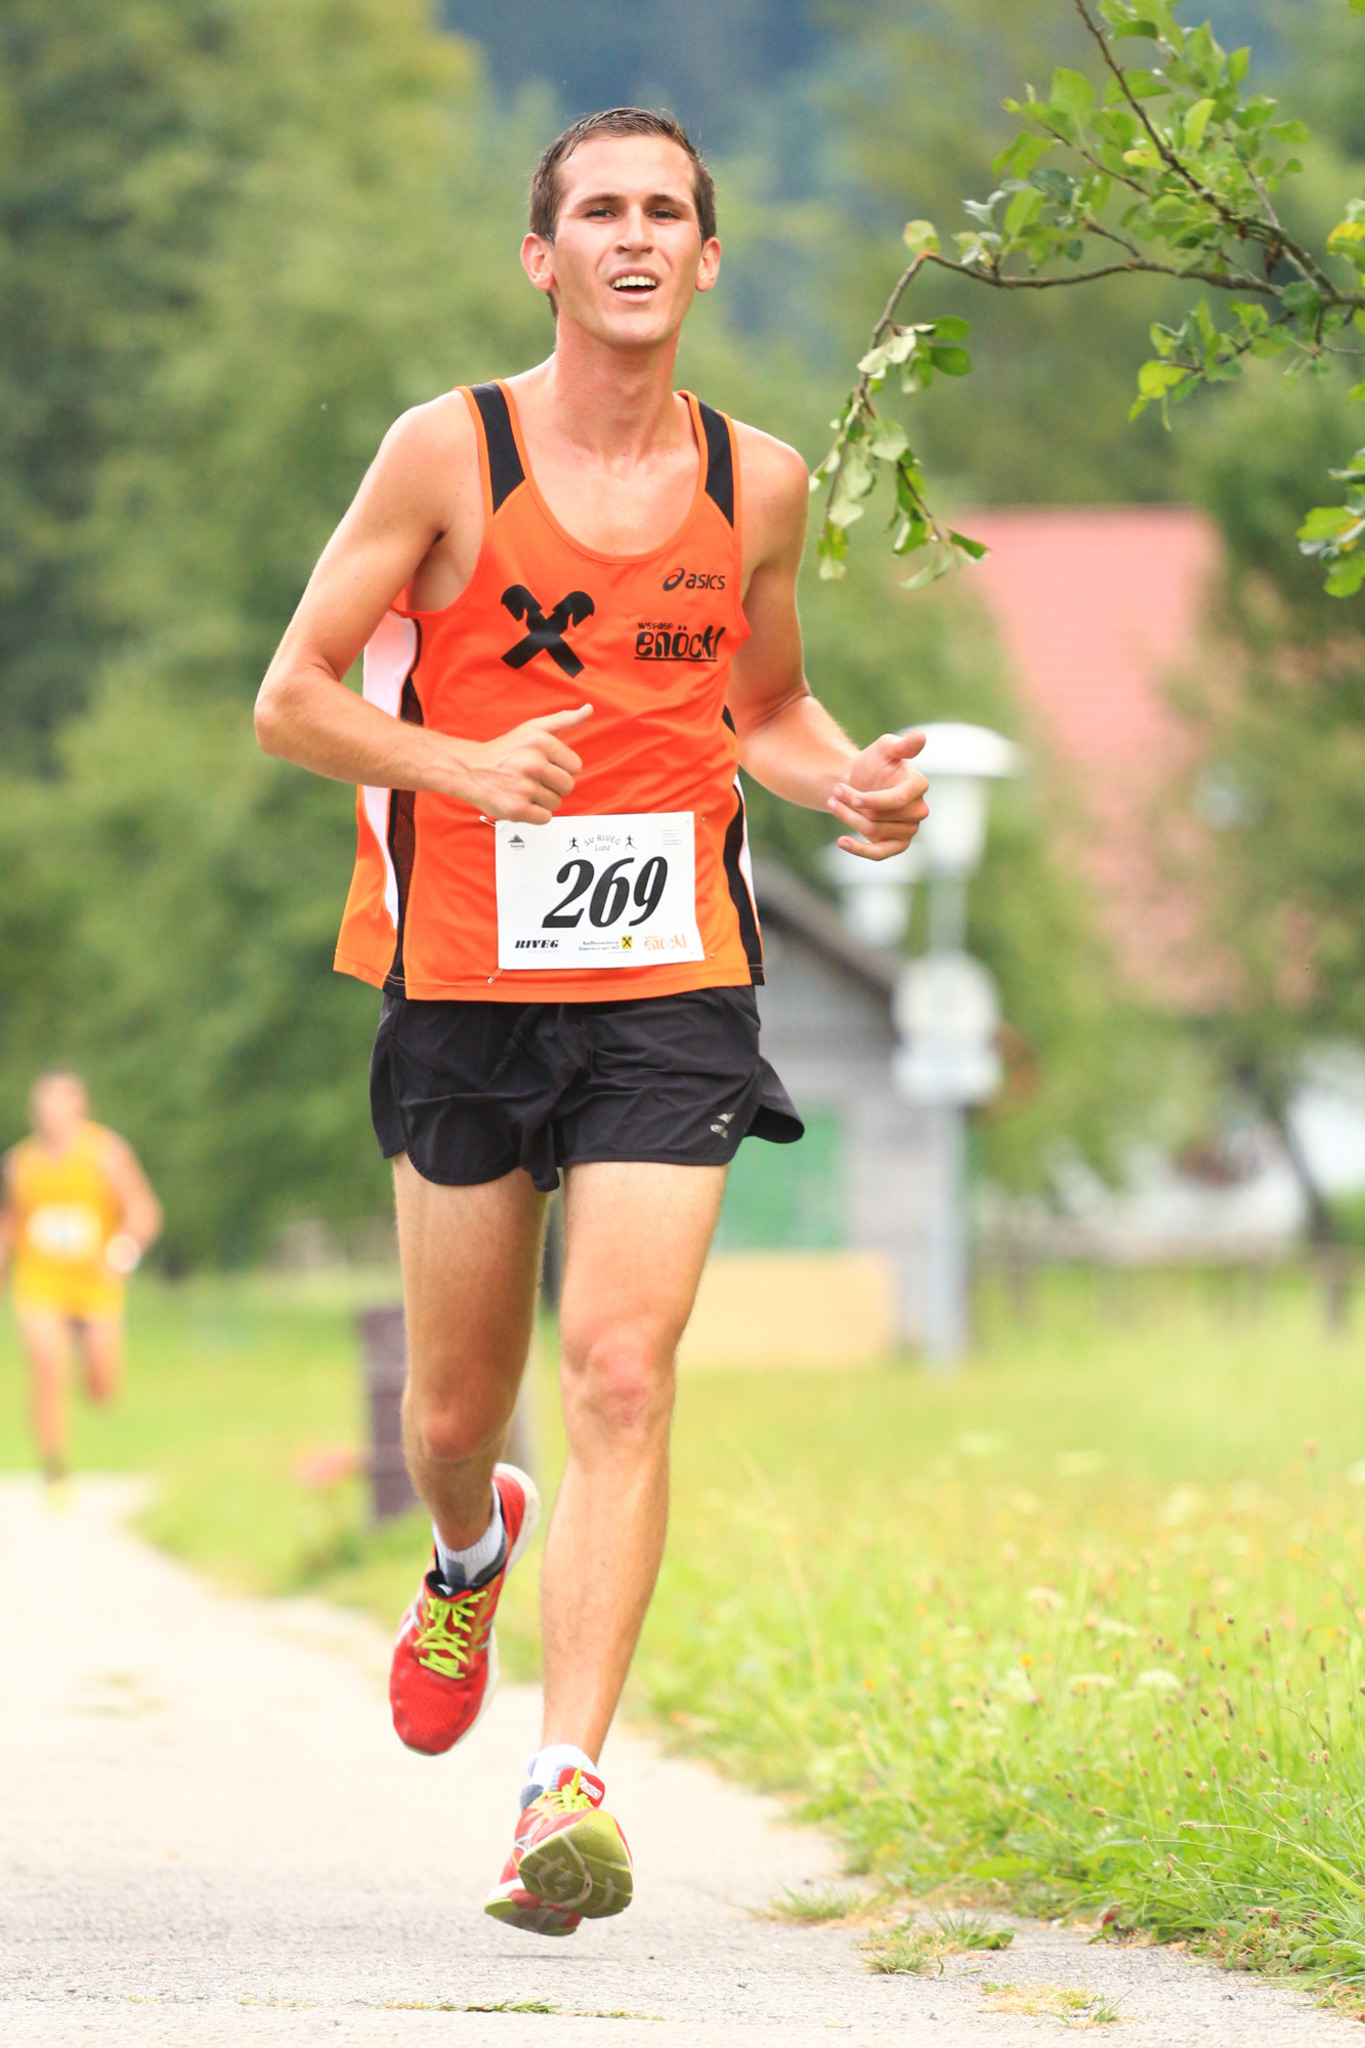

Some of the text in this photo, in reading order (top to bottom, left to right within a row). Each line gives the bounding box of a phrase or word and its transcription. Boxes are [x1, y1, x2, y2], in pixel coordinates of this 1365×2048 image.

[685, 573, 726, 590] asics
[541, 856, 669, 929] 269
[514, 939, 560, 949] RIVEG
